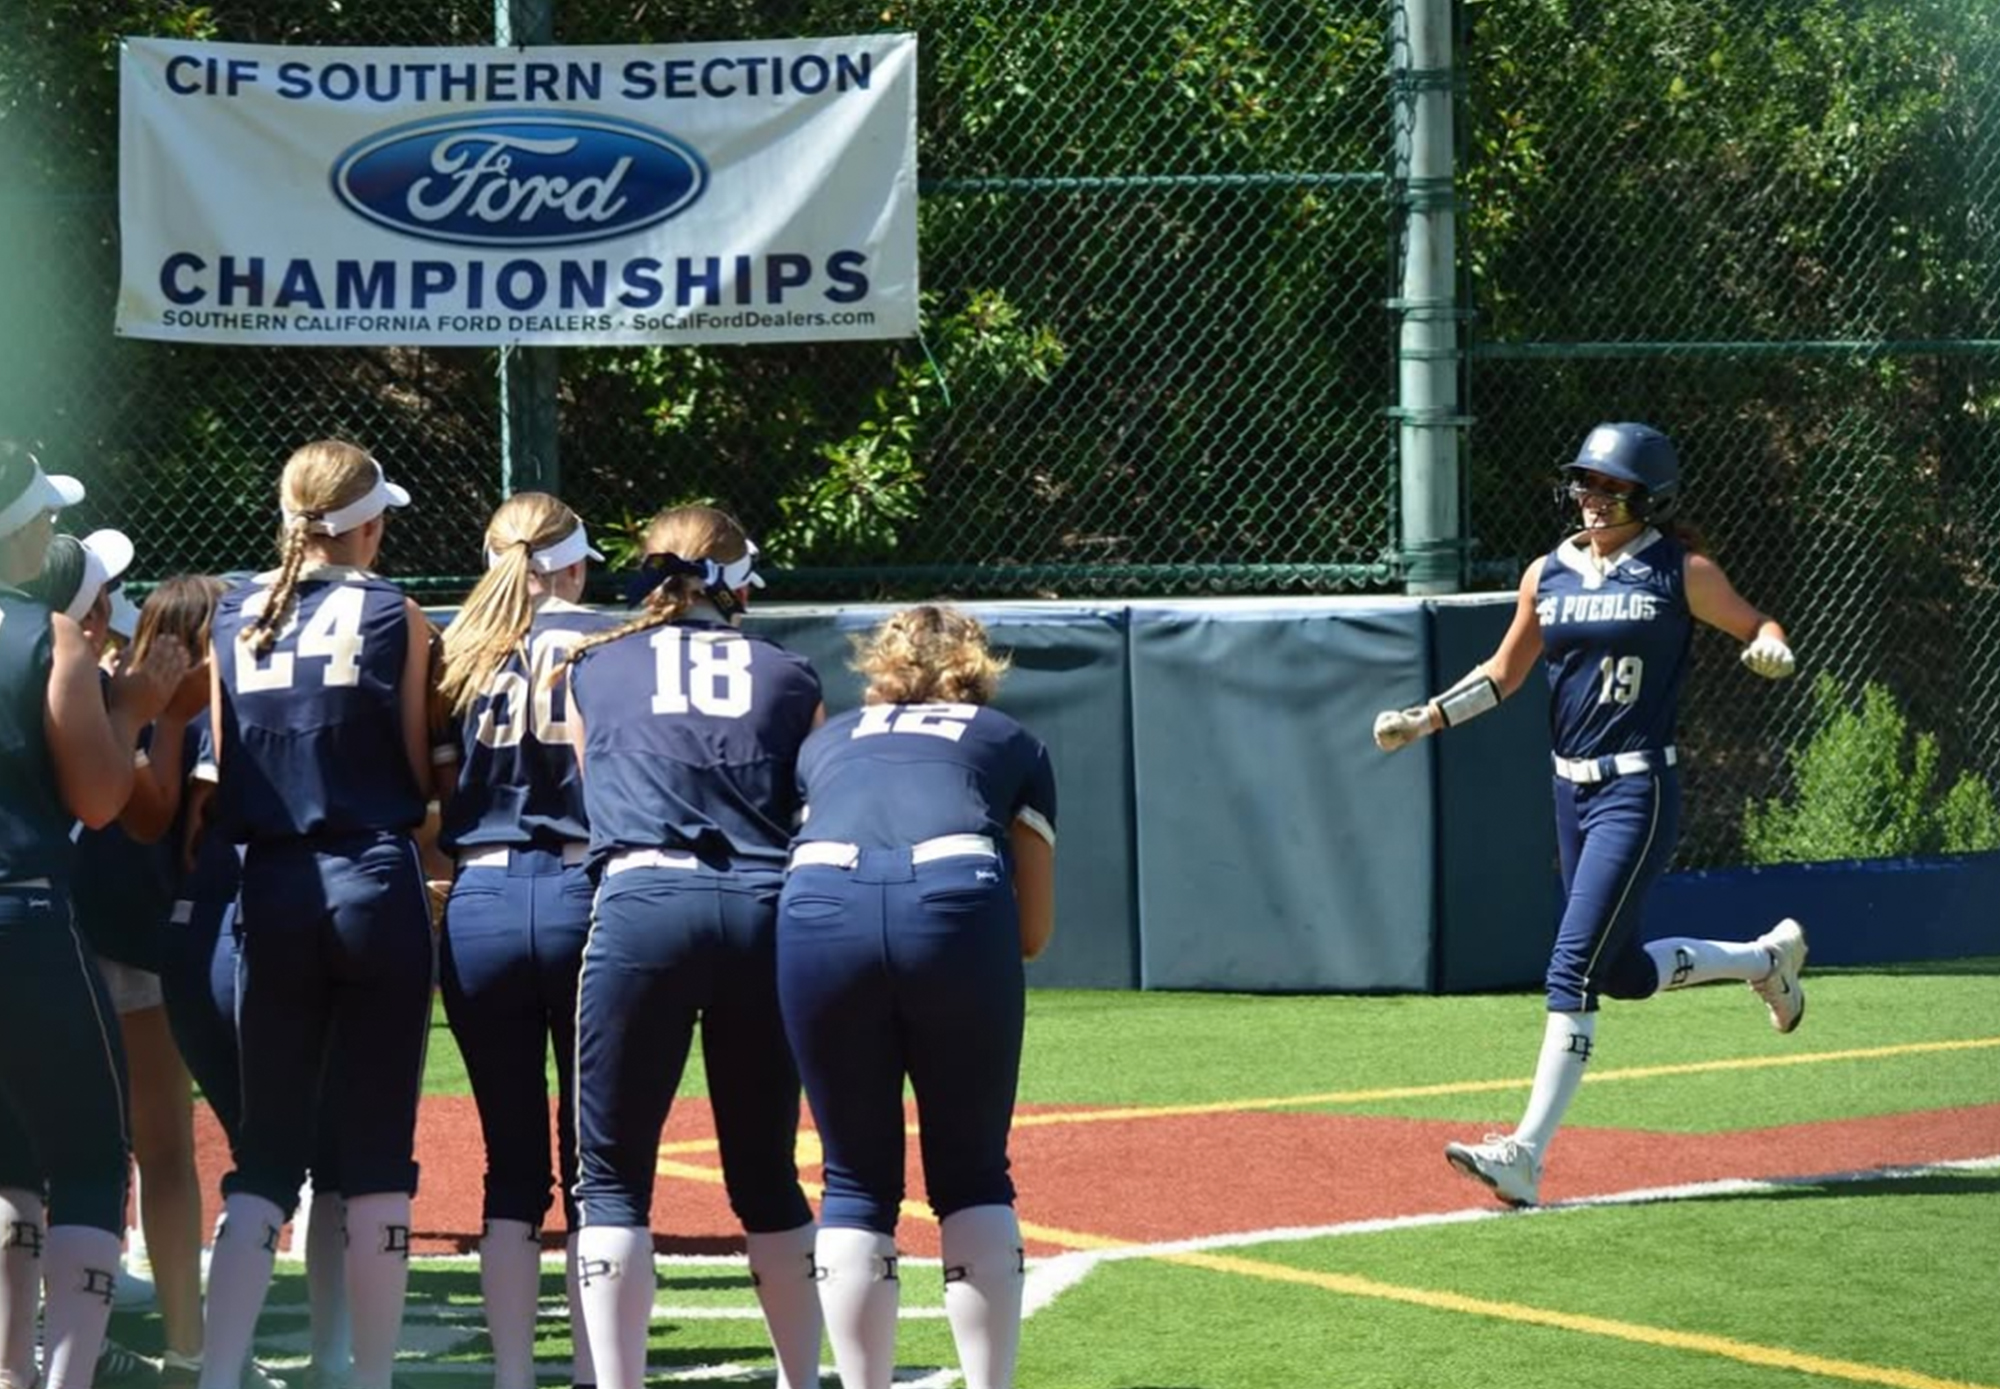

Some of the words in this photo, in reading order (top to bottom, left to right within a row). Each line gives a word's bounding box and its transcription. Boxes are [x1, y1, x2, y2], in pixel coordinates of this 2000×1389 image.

[165, 55, 259, 96] CIF
[276, 62, 601, 102] SOUTHERN
[621, 52, 872, 99] SECTION
[406, 133, 633, 222] Ford
[159, 249, 870, 311] CHAMPIONSHIPS
[162, 309, 288, 331] SOUTHERN
[294, 314, 431, 333] CALIFORNIA
[438, 315, 501, 333] FORD
[508, 315, 612, 332] DEALERS
[633, 309, 875, 331] SoCalFordDealers.com
[1560, 592, 1657, 624] PUEBLOS
[234, 586, 366, 694] 24
[650, 626, 753, 718] 18
[1598, 655, 1643, 705] 19
